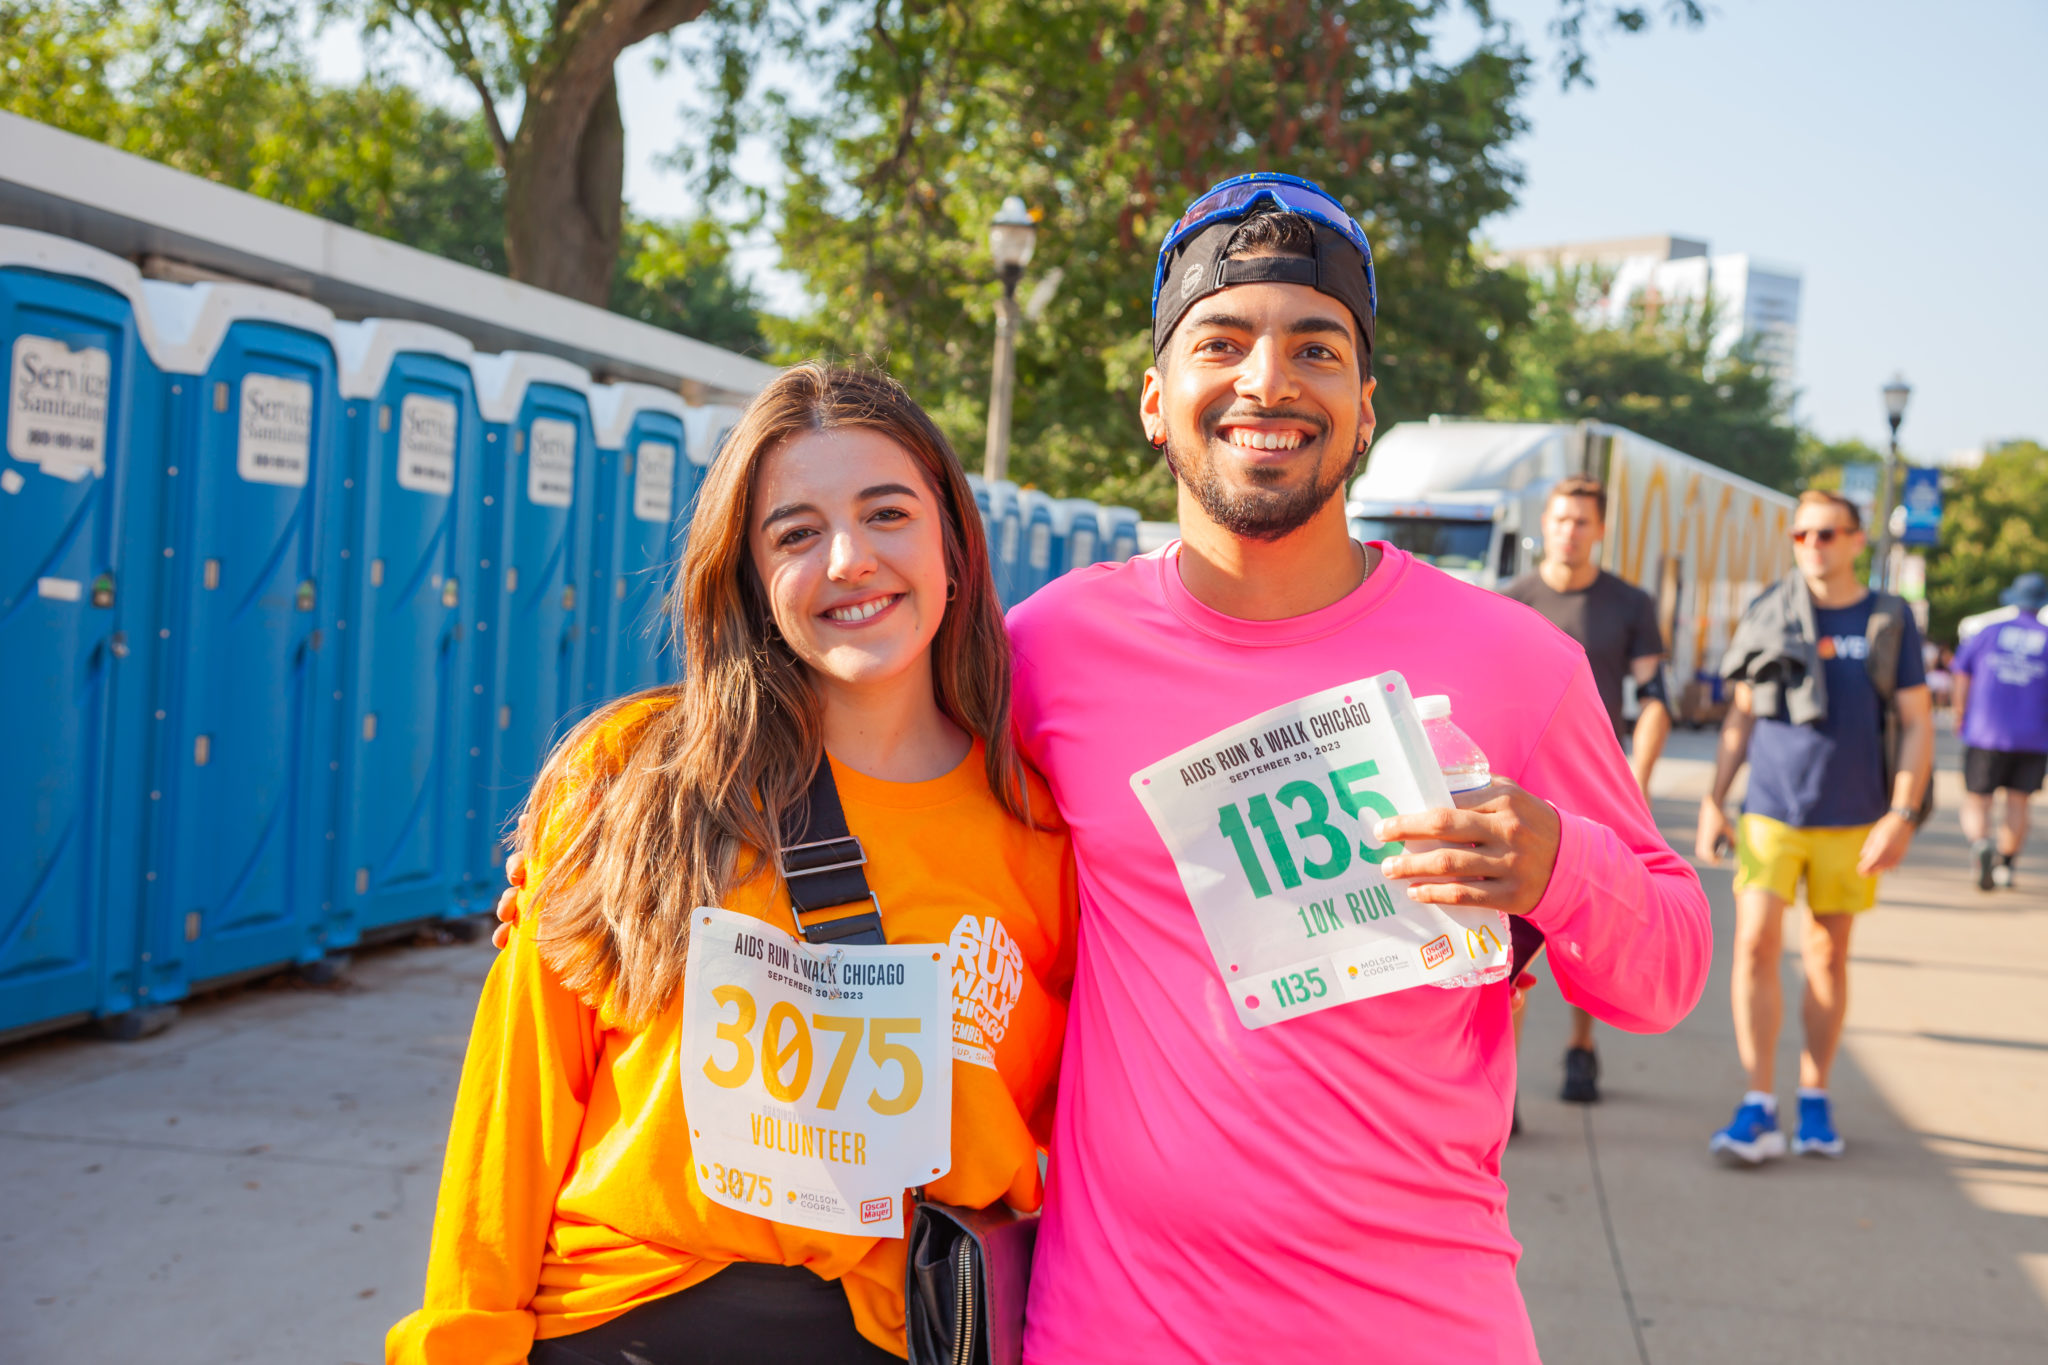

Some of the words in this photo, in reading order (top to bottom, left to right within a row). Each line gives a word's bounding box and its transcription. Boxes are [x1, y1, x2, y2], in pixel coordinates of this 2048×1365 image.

[1180, 757, 1216, 787] AIDS
[1215, 743, 1251, 771] RUN
[1250, 737, 1265, 758] &
[1263, 720, 1310, 753] WALK
[1309, 702, 1371, 739] CHICAGO
[1229, 756, 1292, 784] SEPTEMBER
[1294, 750, 1312, 763] 30,
[1314, 741, 1342, 756] 2023
[1217, 759, 1407, 899] 1135
[1297, 898, 1344, 939] 10K
[1345, 883, 1396, 925] RUN
[734, 932, 764, 961] AIDS
[767, 942, 790, 971] RUN
[792, 954, 800, 974] &
[800, 957, 838, 985] WALK
[843, 963, 905, 986] CHICAGO
[951, 914, 1024, 972] AIDS
[1360, 954, 1399, 970] MOLSON
[1425, 939, 1446, 956] Oscar
[1426, 946, 1450, 964] Mayer
[767, 970, 813, 995] SEPTEMBER
[815, 989, 829, 998] 30
[950, 934, 1024, 1004] RUN
[1271, 967, 1327, 1009] 1135
[1363, 963, 1396, 978] COORS
[952, 968, 1015, 1029] WALK
[952, 996, 1005, 1044] HICAGO
[702, 984, 924, 1116] 3075
[952, 1021, 984, 1045] EMBER
[750, 1112, 867, 1166] VOLUNTEER
[713, 1162, 773, 1208] 3075
[800, 1192, 838, 1205] MOLSON
[800, 1200, 831, 1213] COORS
[865, 1201, 888, 1212] Oscar
[864, 1208, 889, 1221] Mayer
